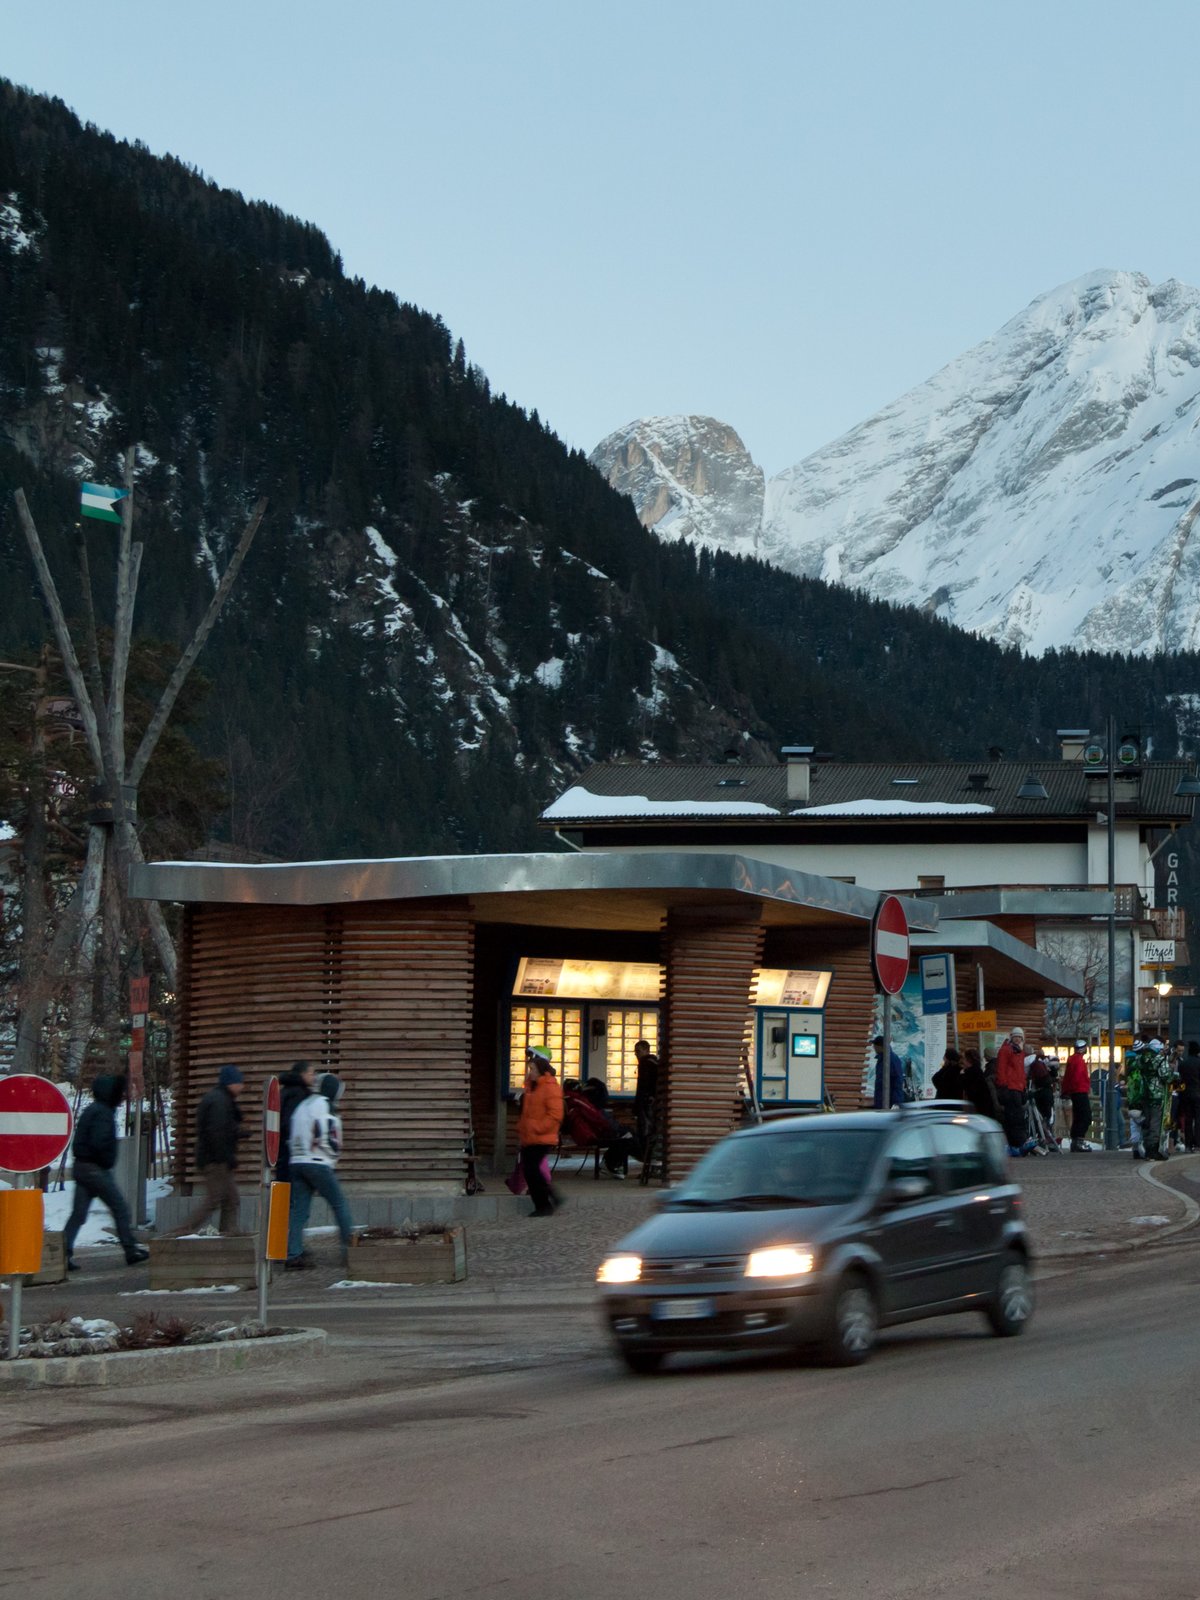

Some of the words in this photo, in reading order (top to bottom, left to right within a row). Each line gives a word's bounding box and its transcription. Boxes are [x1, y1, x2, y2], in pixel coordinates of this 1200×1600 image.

[1167, 853, 1179, 937] GARNI
[962, 1021, 974, 1030] SKI
[976, 1020, 992, 1029] BUS
